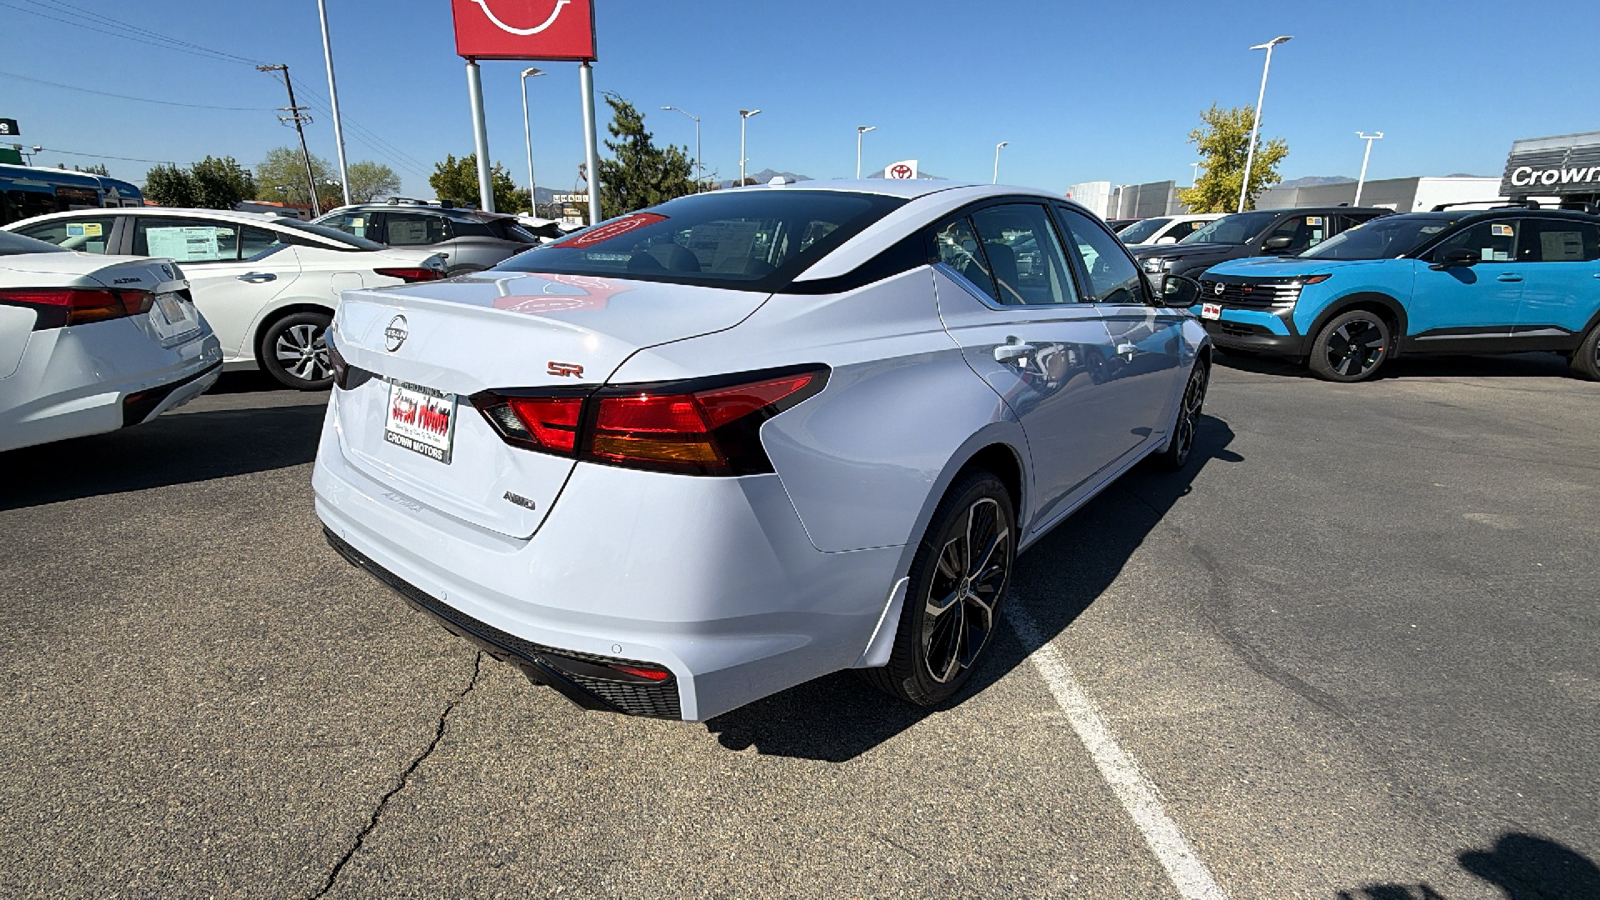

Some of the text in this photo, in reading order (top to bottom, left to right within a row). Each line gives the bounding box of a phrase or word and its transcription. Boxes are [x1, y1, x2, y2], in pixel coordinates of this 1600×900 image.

[1511, 166, 1600, 186] Crown
[547, 361, 583, 379] SR
[387, 432, 412, 449] CROWN
[413, 440, 443, 460] MOTORS
